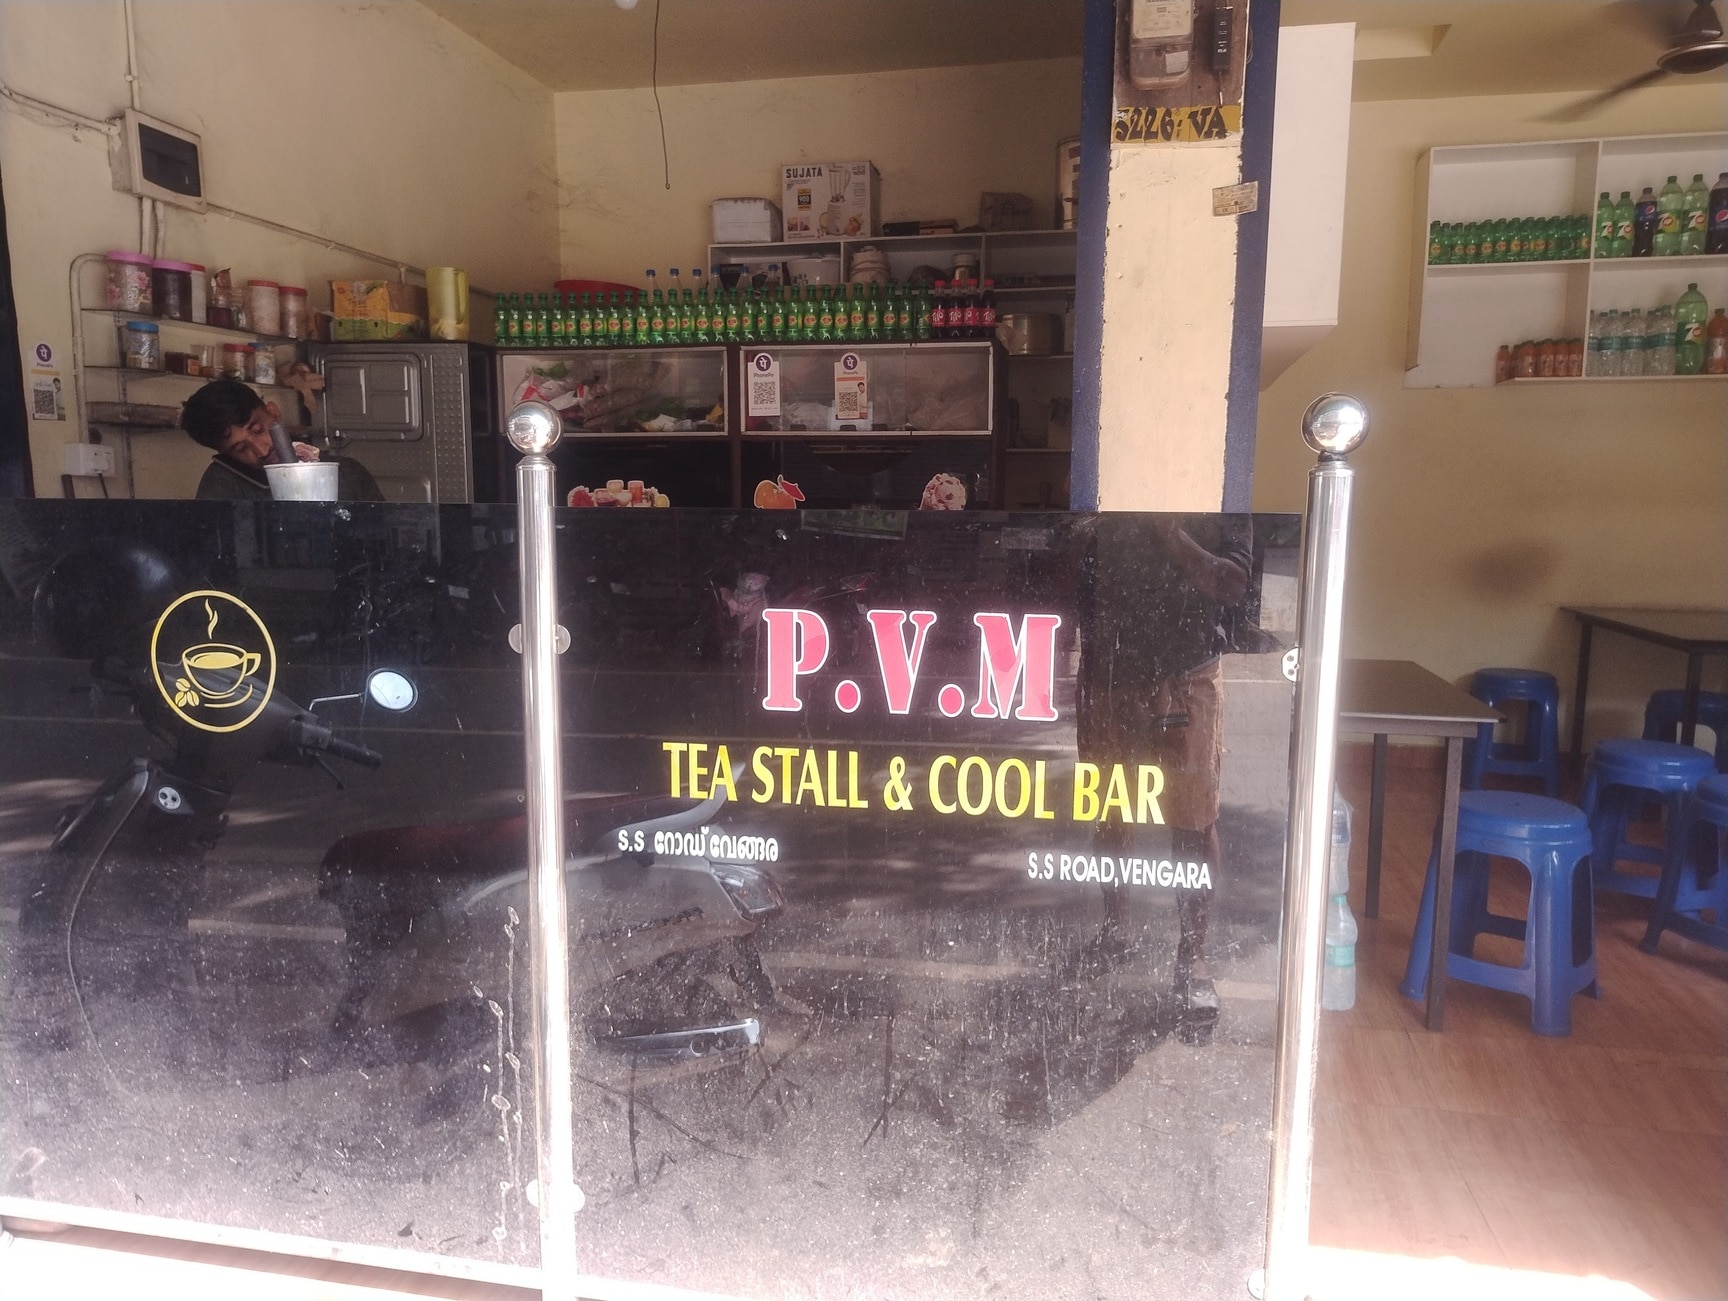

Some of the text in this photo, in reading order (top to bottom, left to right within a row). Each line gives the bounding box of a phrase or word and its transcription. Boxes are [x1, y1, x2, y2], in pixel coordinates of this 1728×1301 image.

[786, 167, 823, 178] SUJATA
[762, 608, 1061, 721] P.V.M
[662, 742, 1166, 825] TEA STALL & COOL BAR
[618, 826, 779, 862] S.S റോഡ് വേങ്ങര
[1027, 852, 1054, 880] S.S
